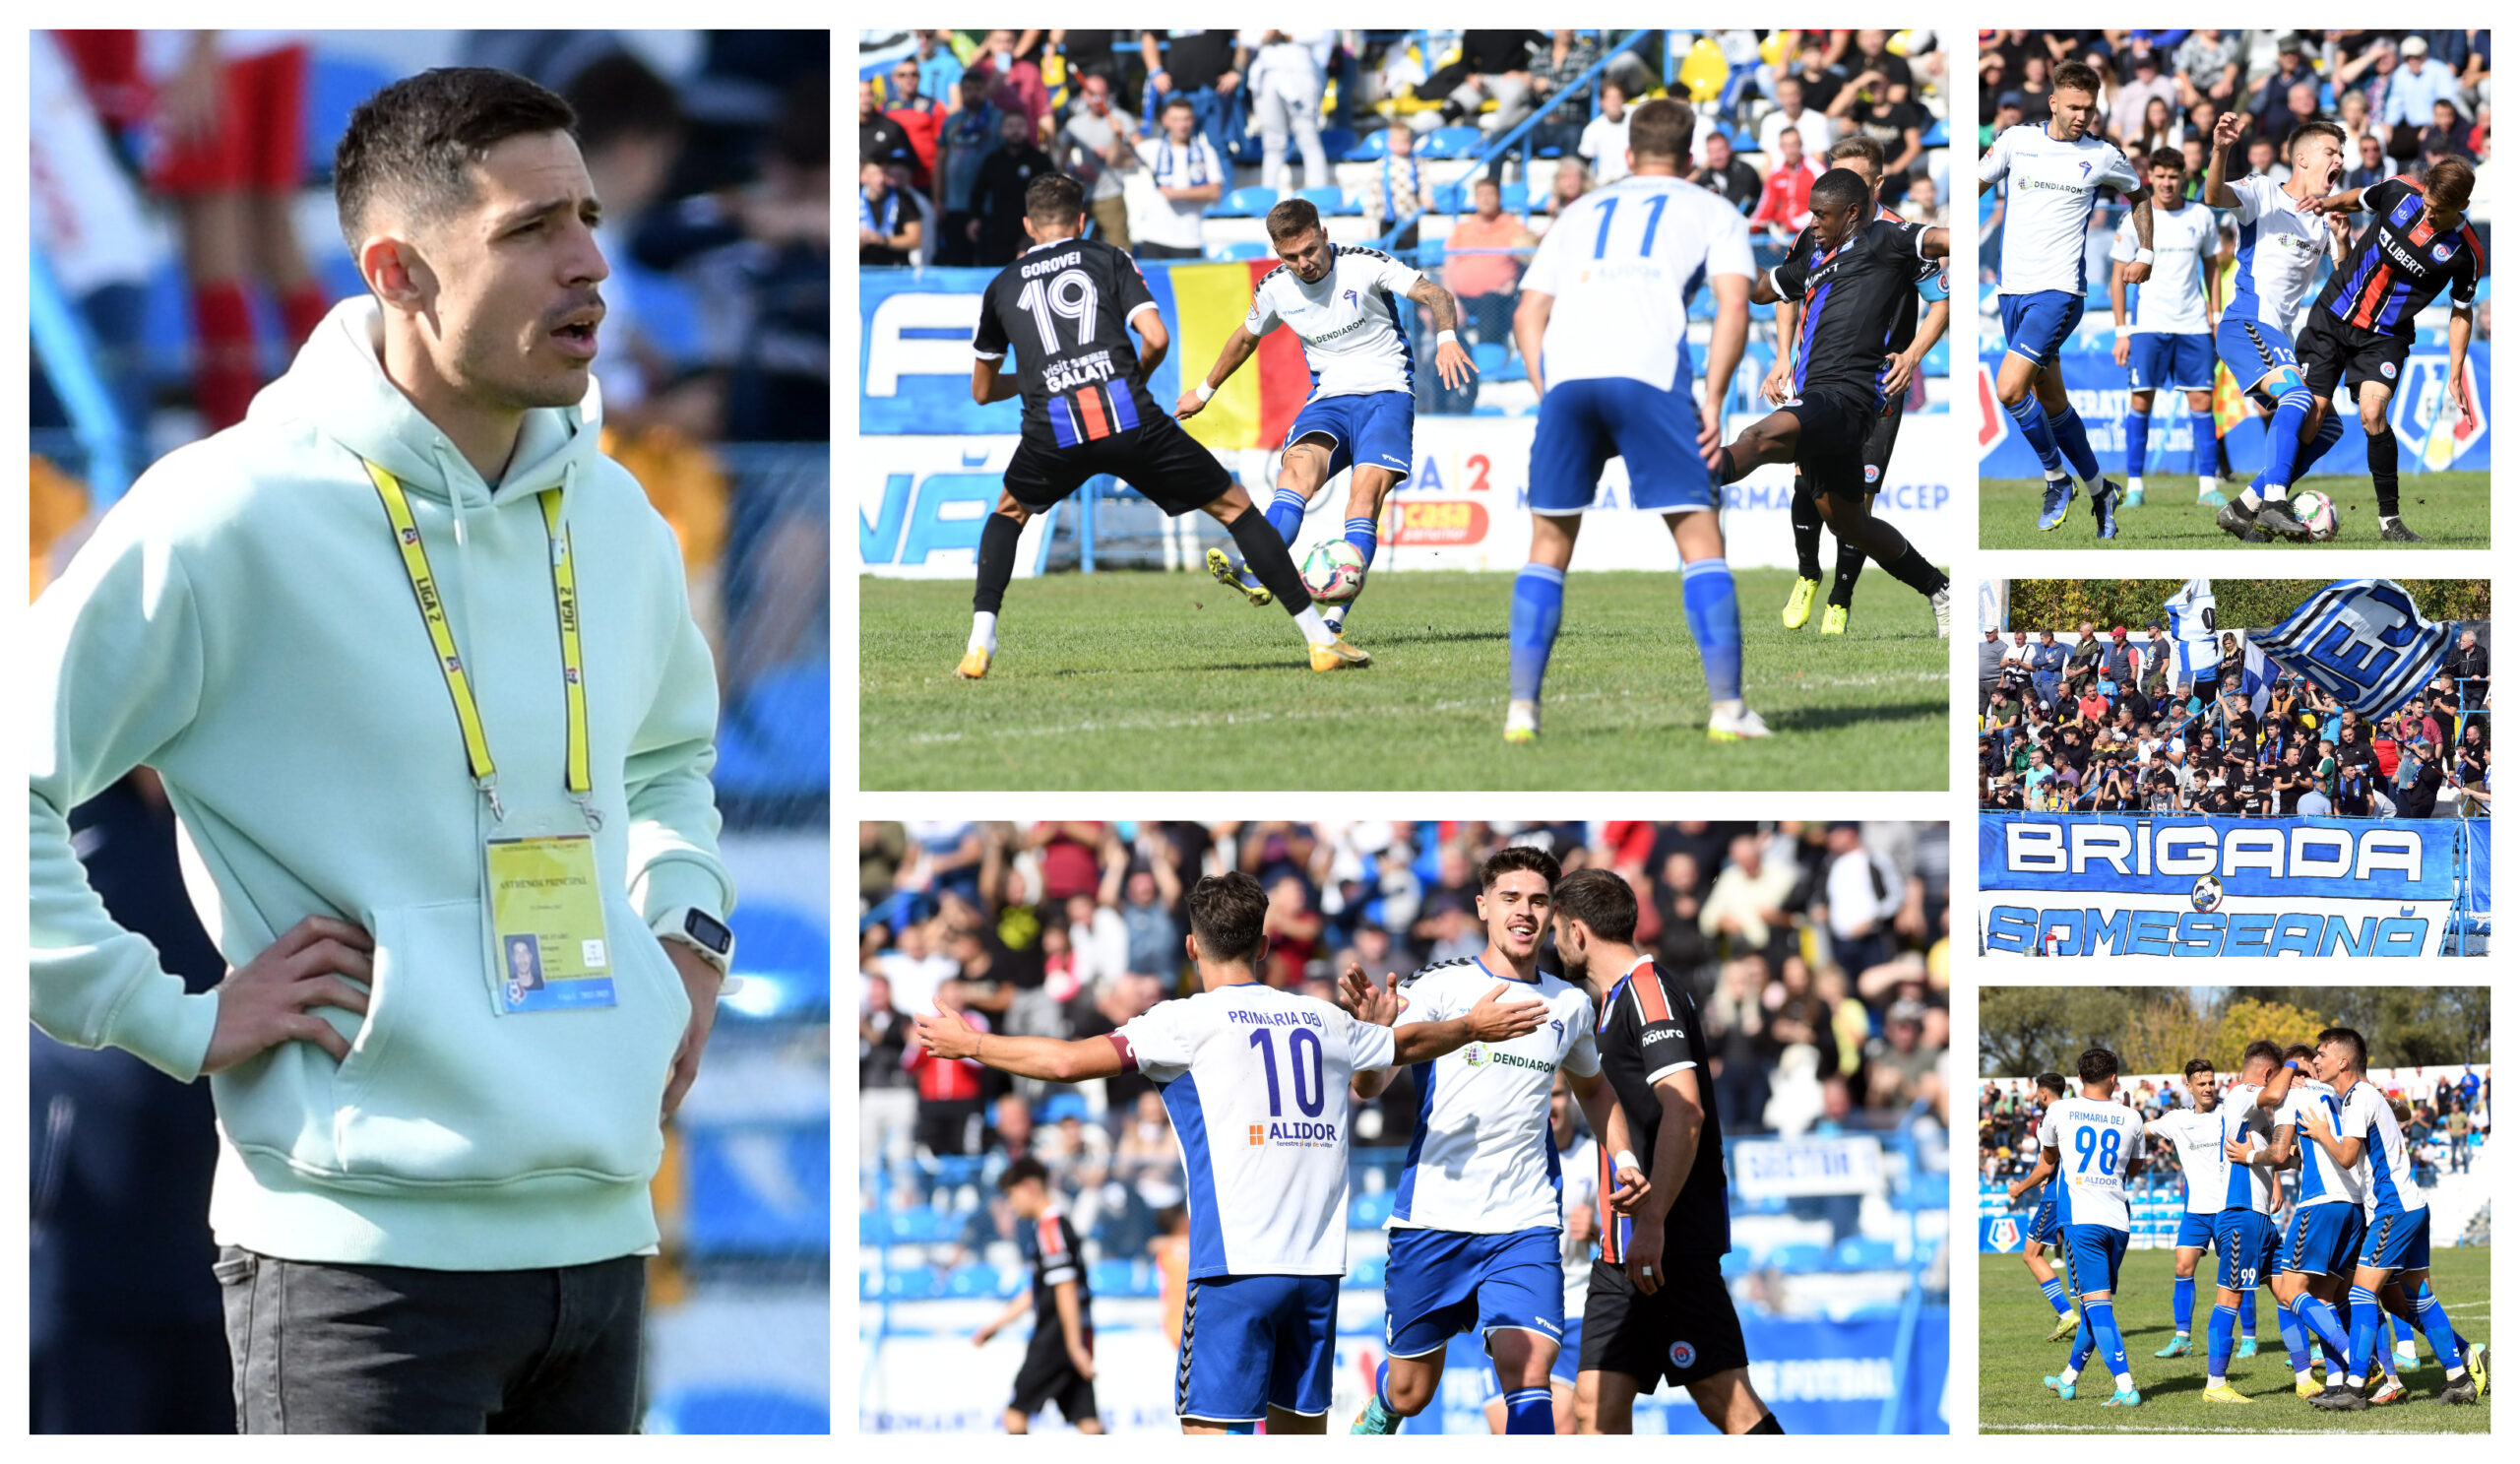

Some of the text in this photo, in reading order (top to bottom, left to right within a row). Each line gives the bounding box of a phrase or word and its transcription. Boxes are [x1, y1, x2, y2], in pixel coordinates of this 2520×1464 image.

[2034, 181, 2083, 195] DENDIAROM
[1594, 194, 1669, 260] 11
[1021, 251, 1081, 279] GOROVEI
[1017, 269, 1098, 356] 19
[1316, 317, 1366, 344] DENDIAROM
[2274, 347, 2297, 363] 13
[1042, 360, 1070, 379] visit
[1467, 454, 1490, 490] 2
[415, 577, 442, 623] LIGA 2
[560, 587, 576, 632] LIGA 2
[1642, 1029, 1684, 1048] natura
[1249, 1027, 1324, 1118] 10
[1493, 1052, 1555, 1075] DENDIAROM
[1269, 1122, 1337, 1141] ALIDOR
[2110, 1115, 2125, 1125] DEJ
[2075, 1125, 2121, 1176] 98
[2085, 1176, 2117, 1186] ALIDOR
[2240, 1268, 2256, 1285] 99
